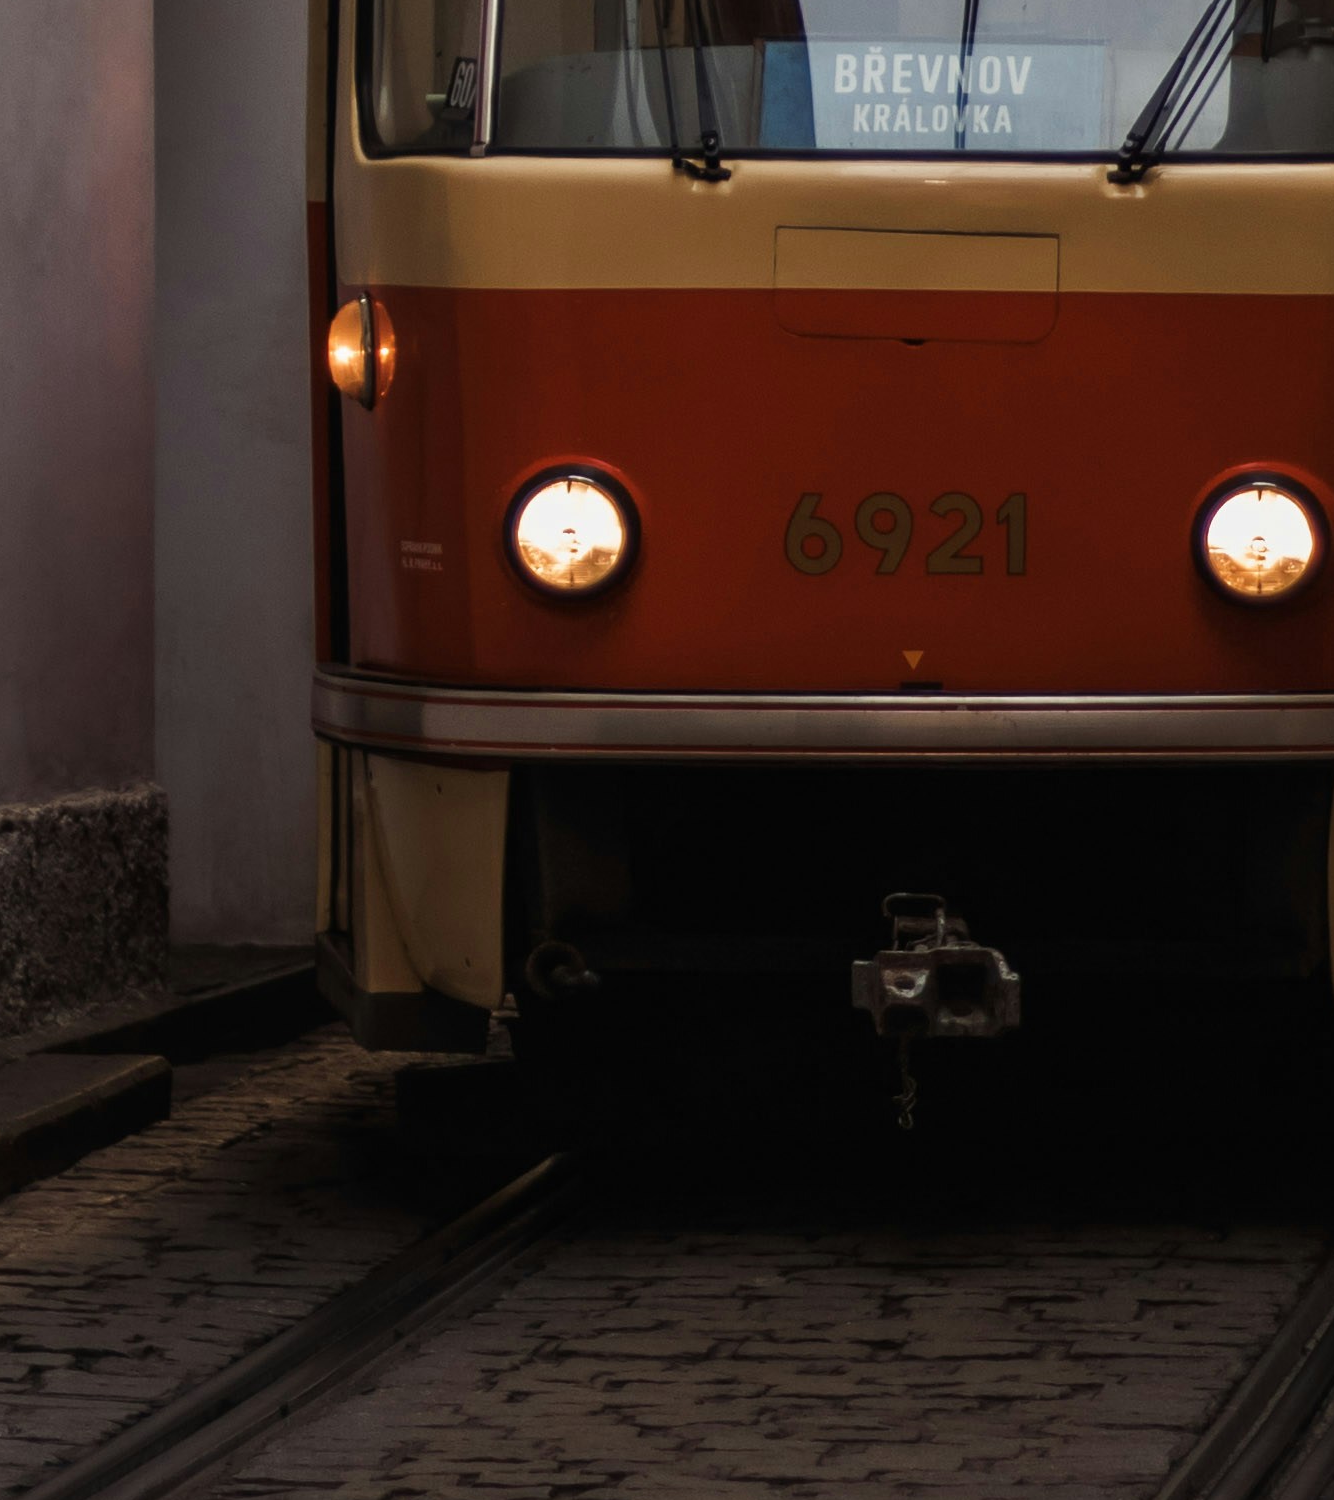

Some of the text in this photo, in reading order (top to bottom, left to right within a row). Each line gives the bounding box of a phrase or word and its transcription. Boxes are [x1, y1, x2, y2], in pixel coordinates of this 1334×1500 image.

[833, 46, 1033, 95] BŘEVNOV
[852, 97, 1013, 134] KRÁLOVKA
[784, 491, 1027, 576] 6921
